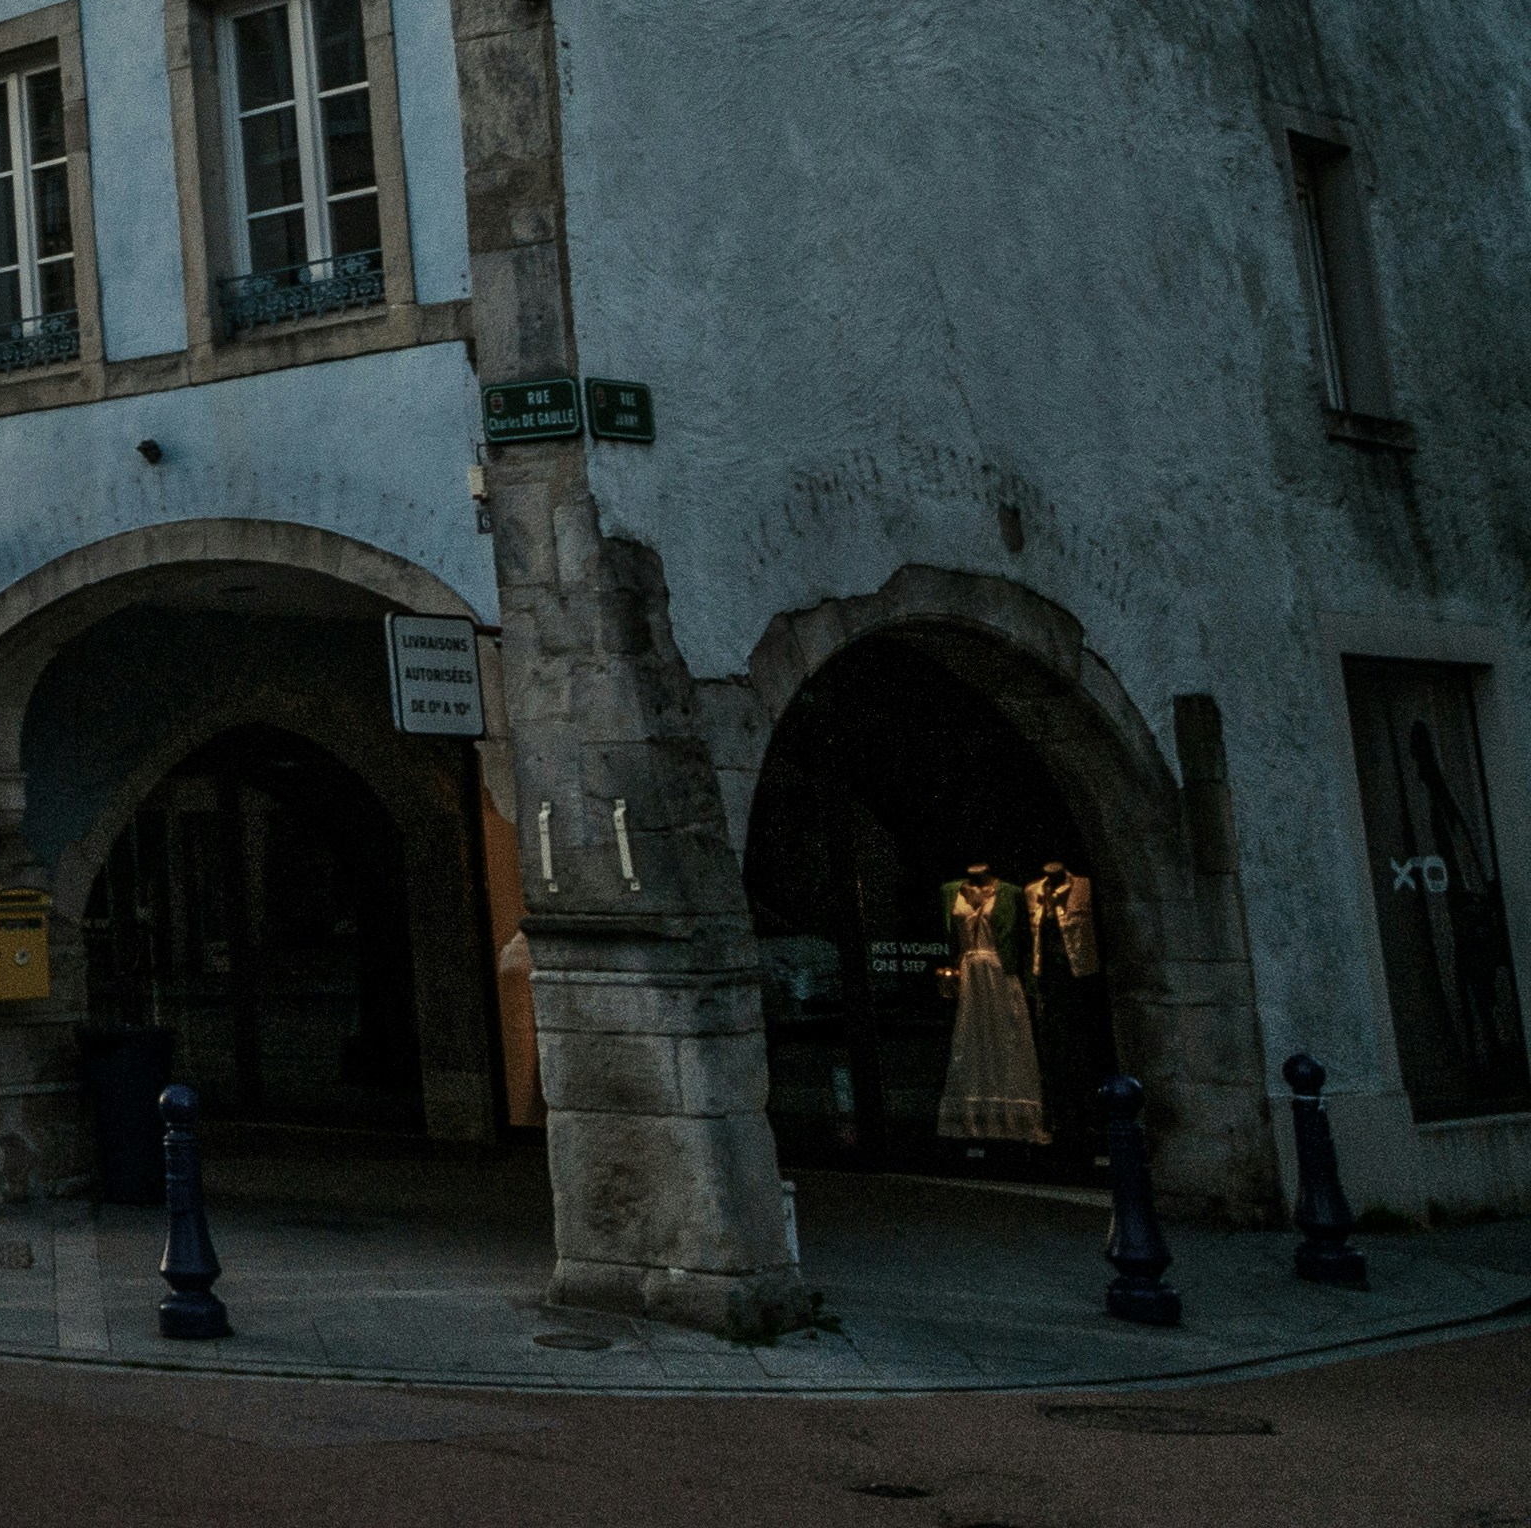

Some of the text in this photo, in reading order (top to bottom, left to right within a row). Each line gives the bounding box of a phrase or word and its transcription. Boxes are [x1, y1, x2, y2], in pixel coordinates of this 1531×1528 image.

[527, 389, 551, 406] RUE
[619, 391, 637, 407] RUE
[489, 408, 575, 432] Charles DE GAULLE
[402, 635, 469, 652] LIVRAISONS
[405, 666, 473, 684] AUTORISÉES
[411, 700, 425, 713] DE
[899, 941, 950, 956] WOMEN
